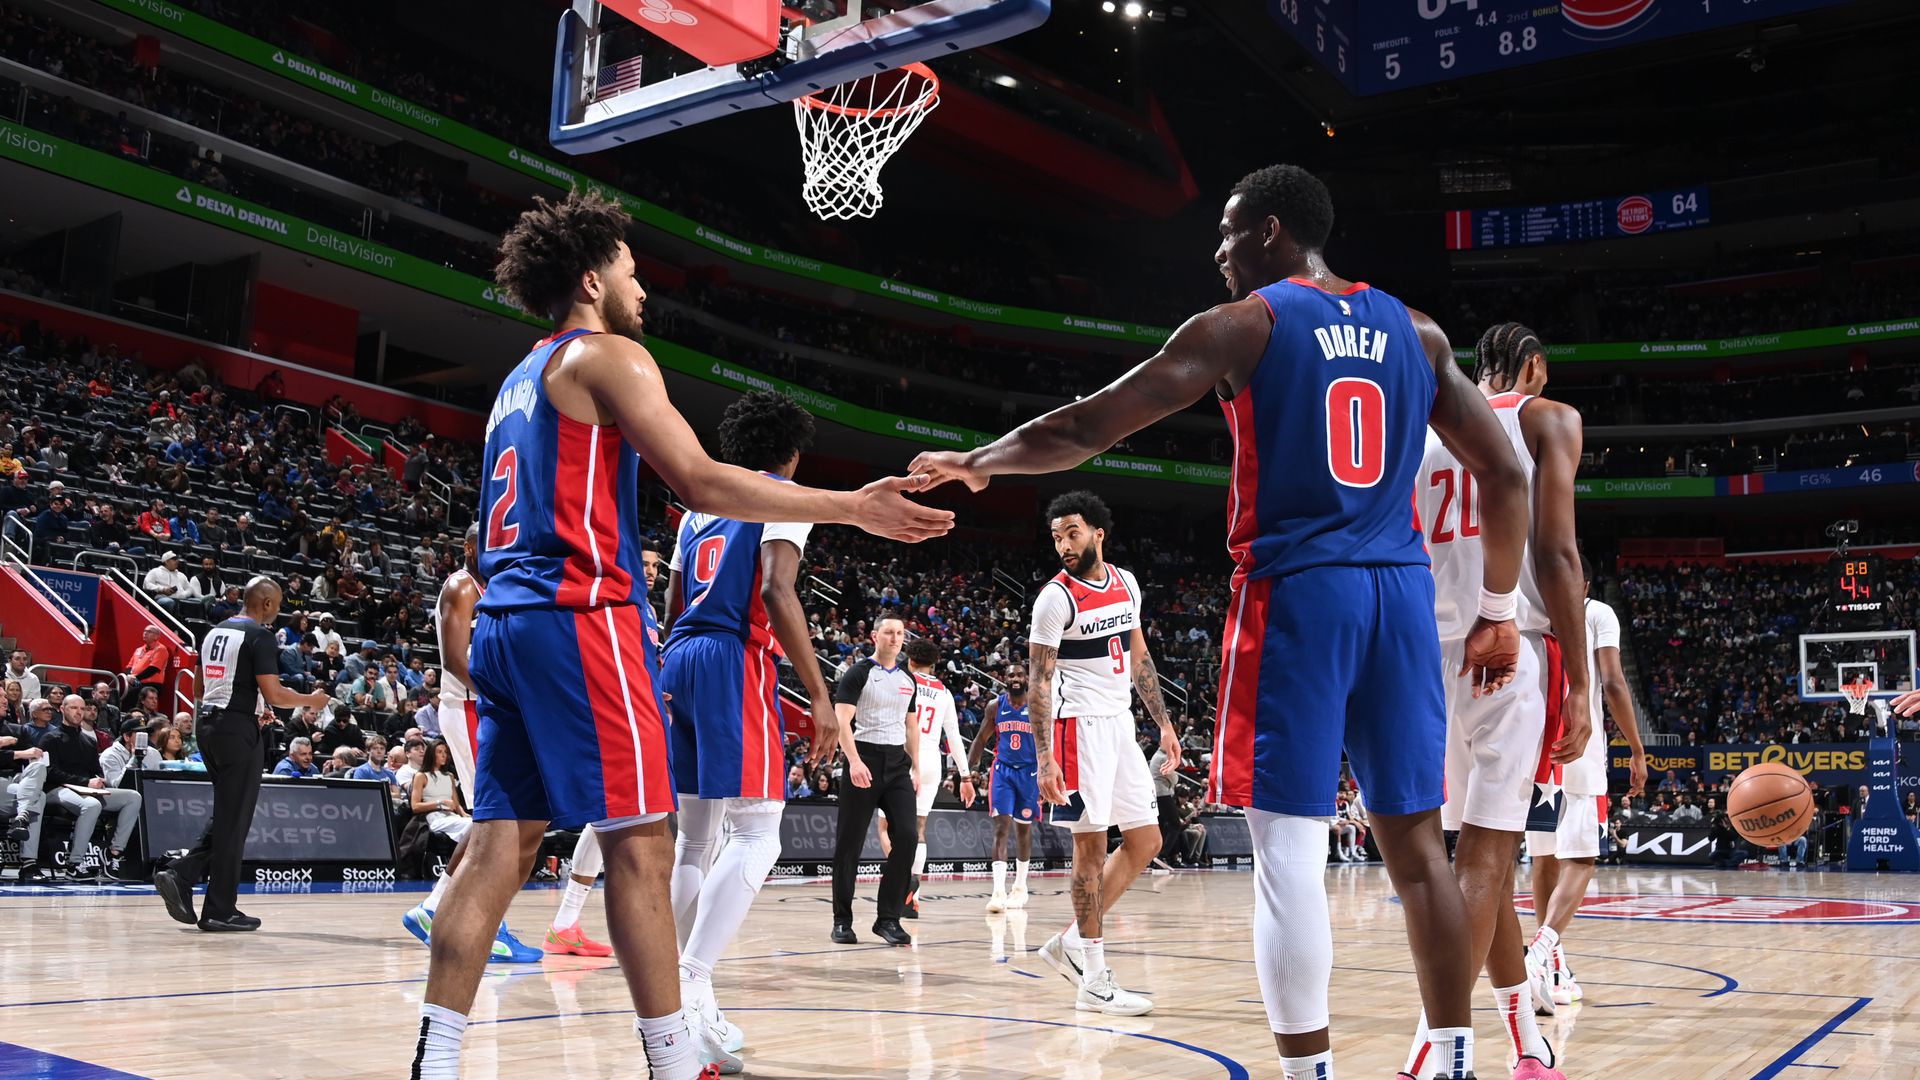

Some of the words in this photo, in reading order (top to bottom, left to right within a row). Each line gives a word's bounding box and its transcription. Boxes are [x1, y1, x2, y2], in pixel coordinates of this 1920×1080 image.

[1475, 10, 1498, 28] 4.4
[1506, 10, 1529, 24] 2nd
[1532, 5, 1559, 18] BONUS
[1316, 24, 1325, 52] 5
[1435, 26, 1462, 39] FOULS:
[1498, 26, 1537, 56] 8.8
[1338, 45, 1346, 74] 5
[1440, 42, 1456, 69] 5
[1385, 53, 1401, 80] 5
[287, 58, 318, 78] DELTA
[319, 71, 358, 96] DENTAL
[371, 88, 440, 127] DeltaVision
[520, 154, 545, 172] DELTA
[1672, 192, 1699, 215] 64
[196, 194, 235, 218] DELTA
[237, 208, 288, 235] DENTAL
[306, 227, 395, 269] DeltaVision
[705, 231, 724, 244] DELTA
[725, 240, 753, 256] DENTAL
[763, 248, 821, 273] DeltaVision
[890, 283, 912, 297] DELTA
[912, 289, 940, 303] DENTAL
[949, 296, 1001, 316] DeltaVision
[1074, 319, 1097, 331] DELTA
[1097, 322, 1126, 334] DENTAL
[1859, 325, 1885, 335] DELTA
[1886, 322, 1919, 332] DENTAL
[1314, 324, 1389, 364] DUREN
[1652, 344, 1676, 353] DELTA
[1677, 343, 1708, 353] DENTAL
[1719, 336, 1779, 350] DeltaVision
[722, 367, 746, 384] DELTA
[907, 423, 932, 437] DELTA
[932, 428, 963, 442] DENTAL
[1325, 376, 1386, 489] 0
[1104, 458, 1131, 470] DELTA
[1132, 461, 1162, 473] DENTAL
[1605, 479, 1674, 493] DeltaVision
[1800, 474, 1832, 487] FG%
[1858, 468, 1882, 484] 46
[486, 445, 520, 552] 2
[690, 535, 726, 606] 9
[1845, 561, 1869, 576] 8.8
[1841, 575, 1871, 601] 4.4
[1848, 602, 1882, 612] TISSOT
[210, 635, 230, 662] 61
[1108, 635, 1125, 675] 9
[918, 686, 938, 700] POOLE
[916, 703, 936, 735] 13
[1009, 733, 1022, 750] 8
[1739, 808, 1796, 832] Wilson
[1861, 827, 1898, 836] HENRY
[1863, 836, 1890, 844] FORD
[792, 837, 815, 849] ON
[1863, 844, 1904, 853] HEALTH
[256, 868, 314, 882] StockX
[343, 867, 396, 881] StockX
[772, 865, 804, 875] StockX
[857, 864, 881, 875] tockX
[928, 862, 955, 873] StockX
[962, 862, 988, 873] StockX
